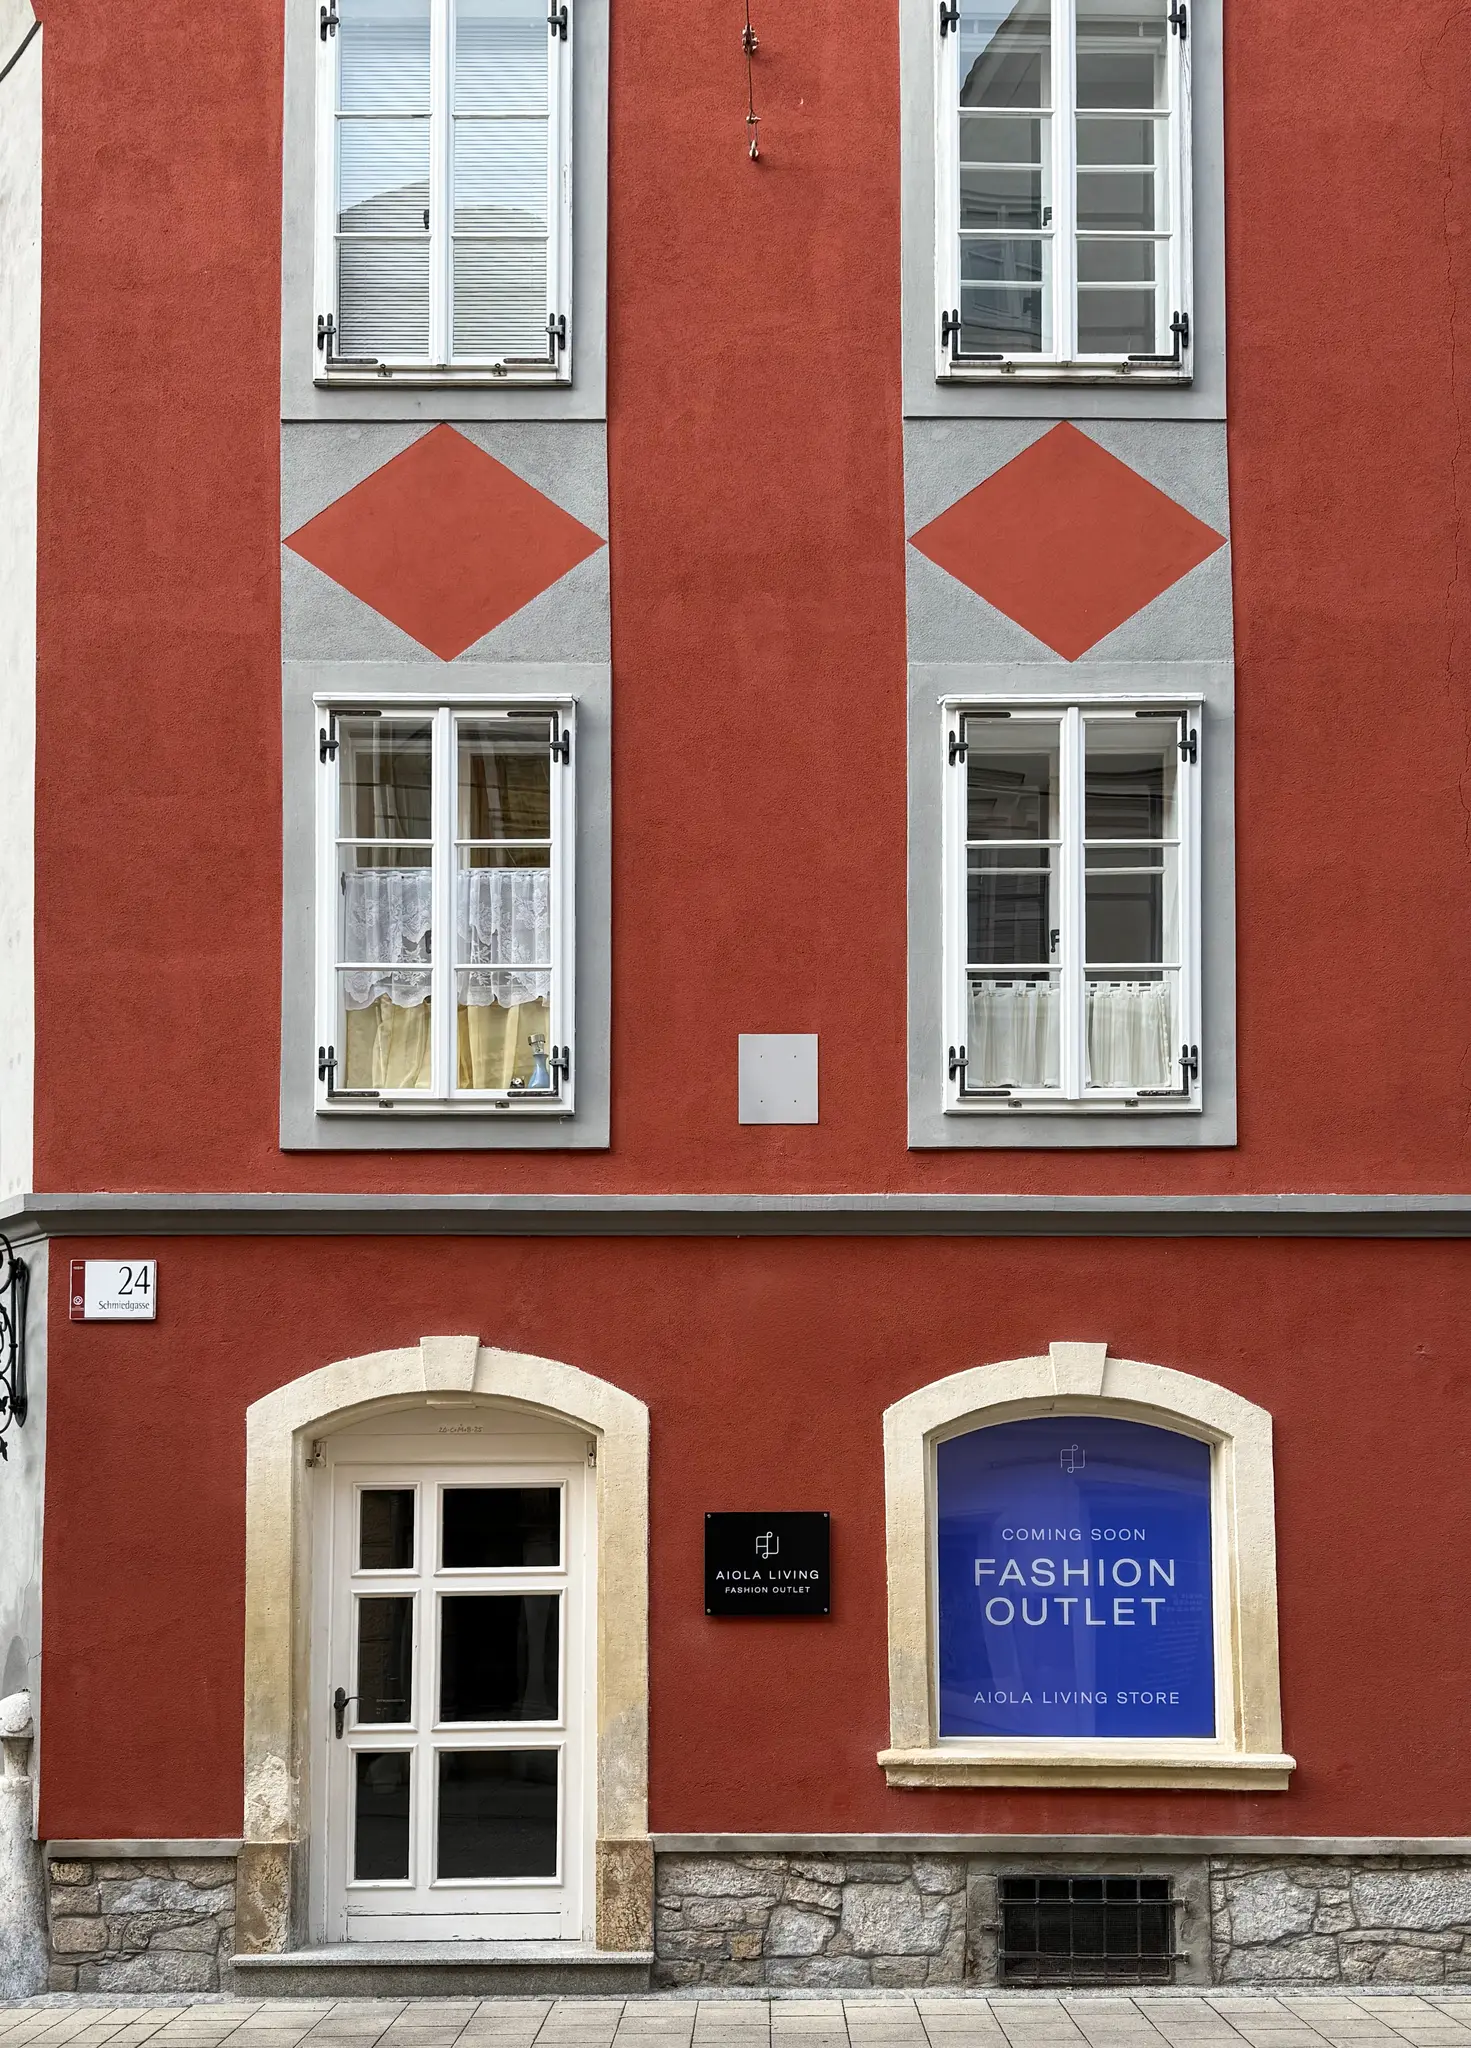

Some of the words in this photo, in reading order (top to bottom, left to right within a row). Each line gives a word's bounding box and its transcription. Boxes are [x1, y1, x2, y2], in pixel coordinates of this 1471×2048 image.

[118, 1265, 151, 1295] 24
[98, 1300, 150, 1312] Schmiedgasse
[1001, 1528, 1082, 1541] COMING
[1090, 1528, 1146, 1541] SOON
[715, 1570, 762, 1580] AIOLA
[769, 1569, 819, 1580] LIVING
[973, 1558, 1175, 1587] FASHION
[724, 1586, 769, 1594] FASHION
[772, 1586, 811, 1594] OUTLET
[985, 1597, 1166, 1626] OUTLET
[973, 1691, 1033, 1704] AIOLA
[1042, 1691, 1108, 1704] LIVING
[1116, 1691, 1180, 1704] STORE
